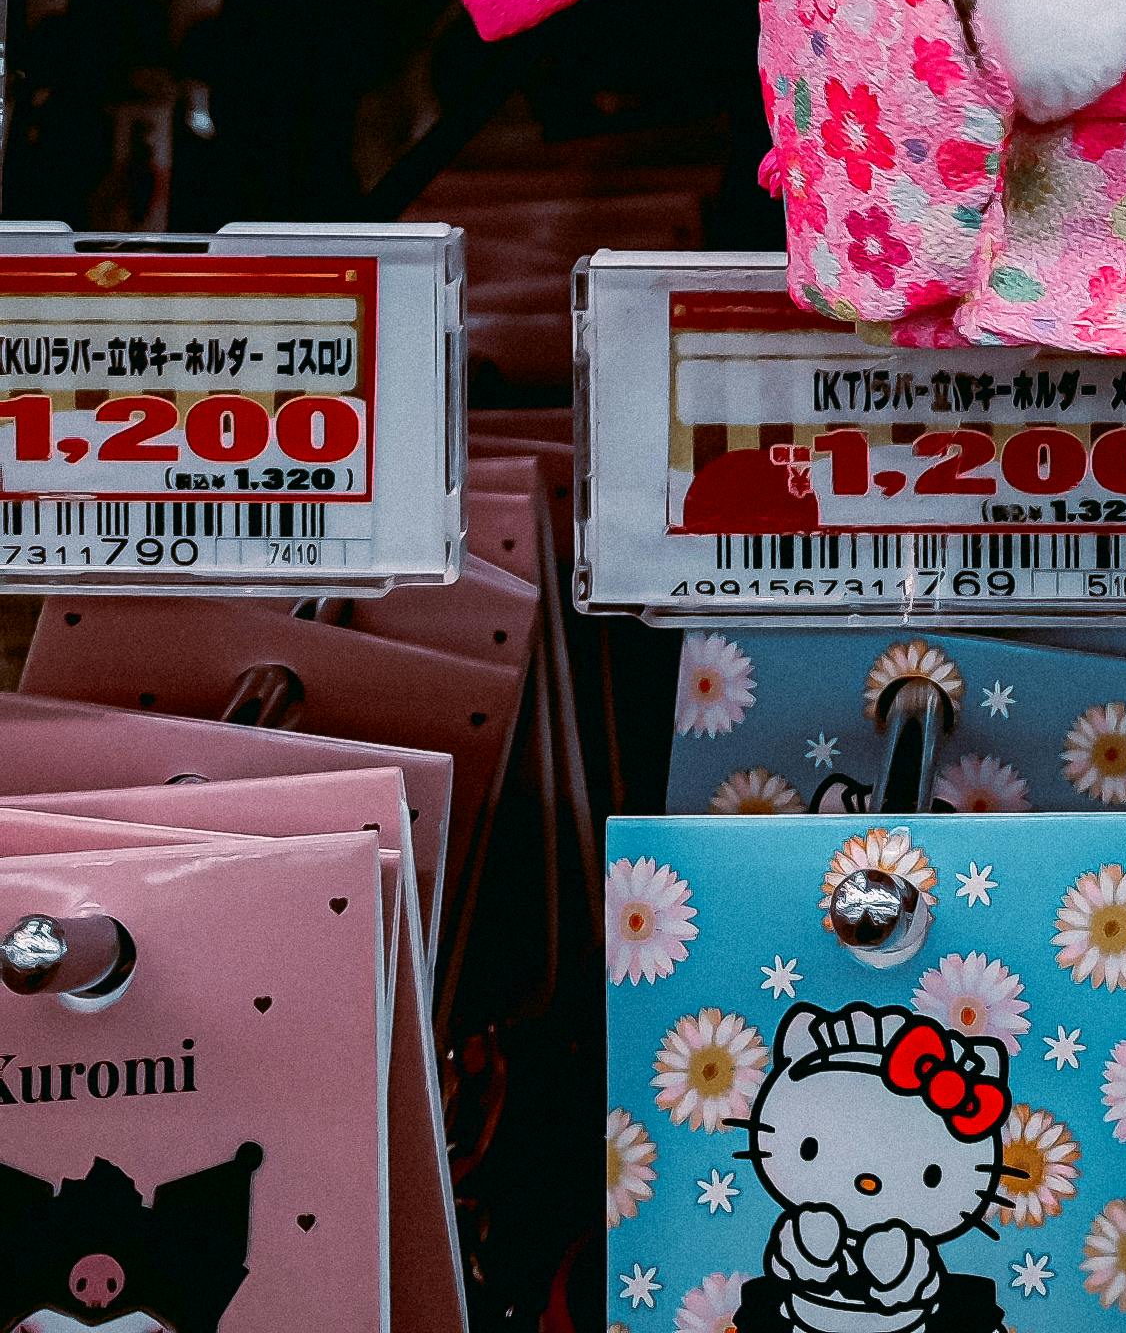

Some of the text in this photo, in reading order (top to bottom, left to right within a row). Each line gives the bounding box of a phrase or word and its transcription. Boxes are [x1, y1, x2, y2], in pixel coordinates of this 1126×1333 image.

[276, 336, 354, 378] ゴスロリ
[0, 395, 361, 464] 1,200
